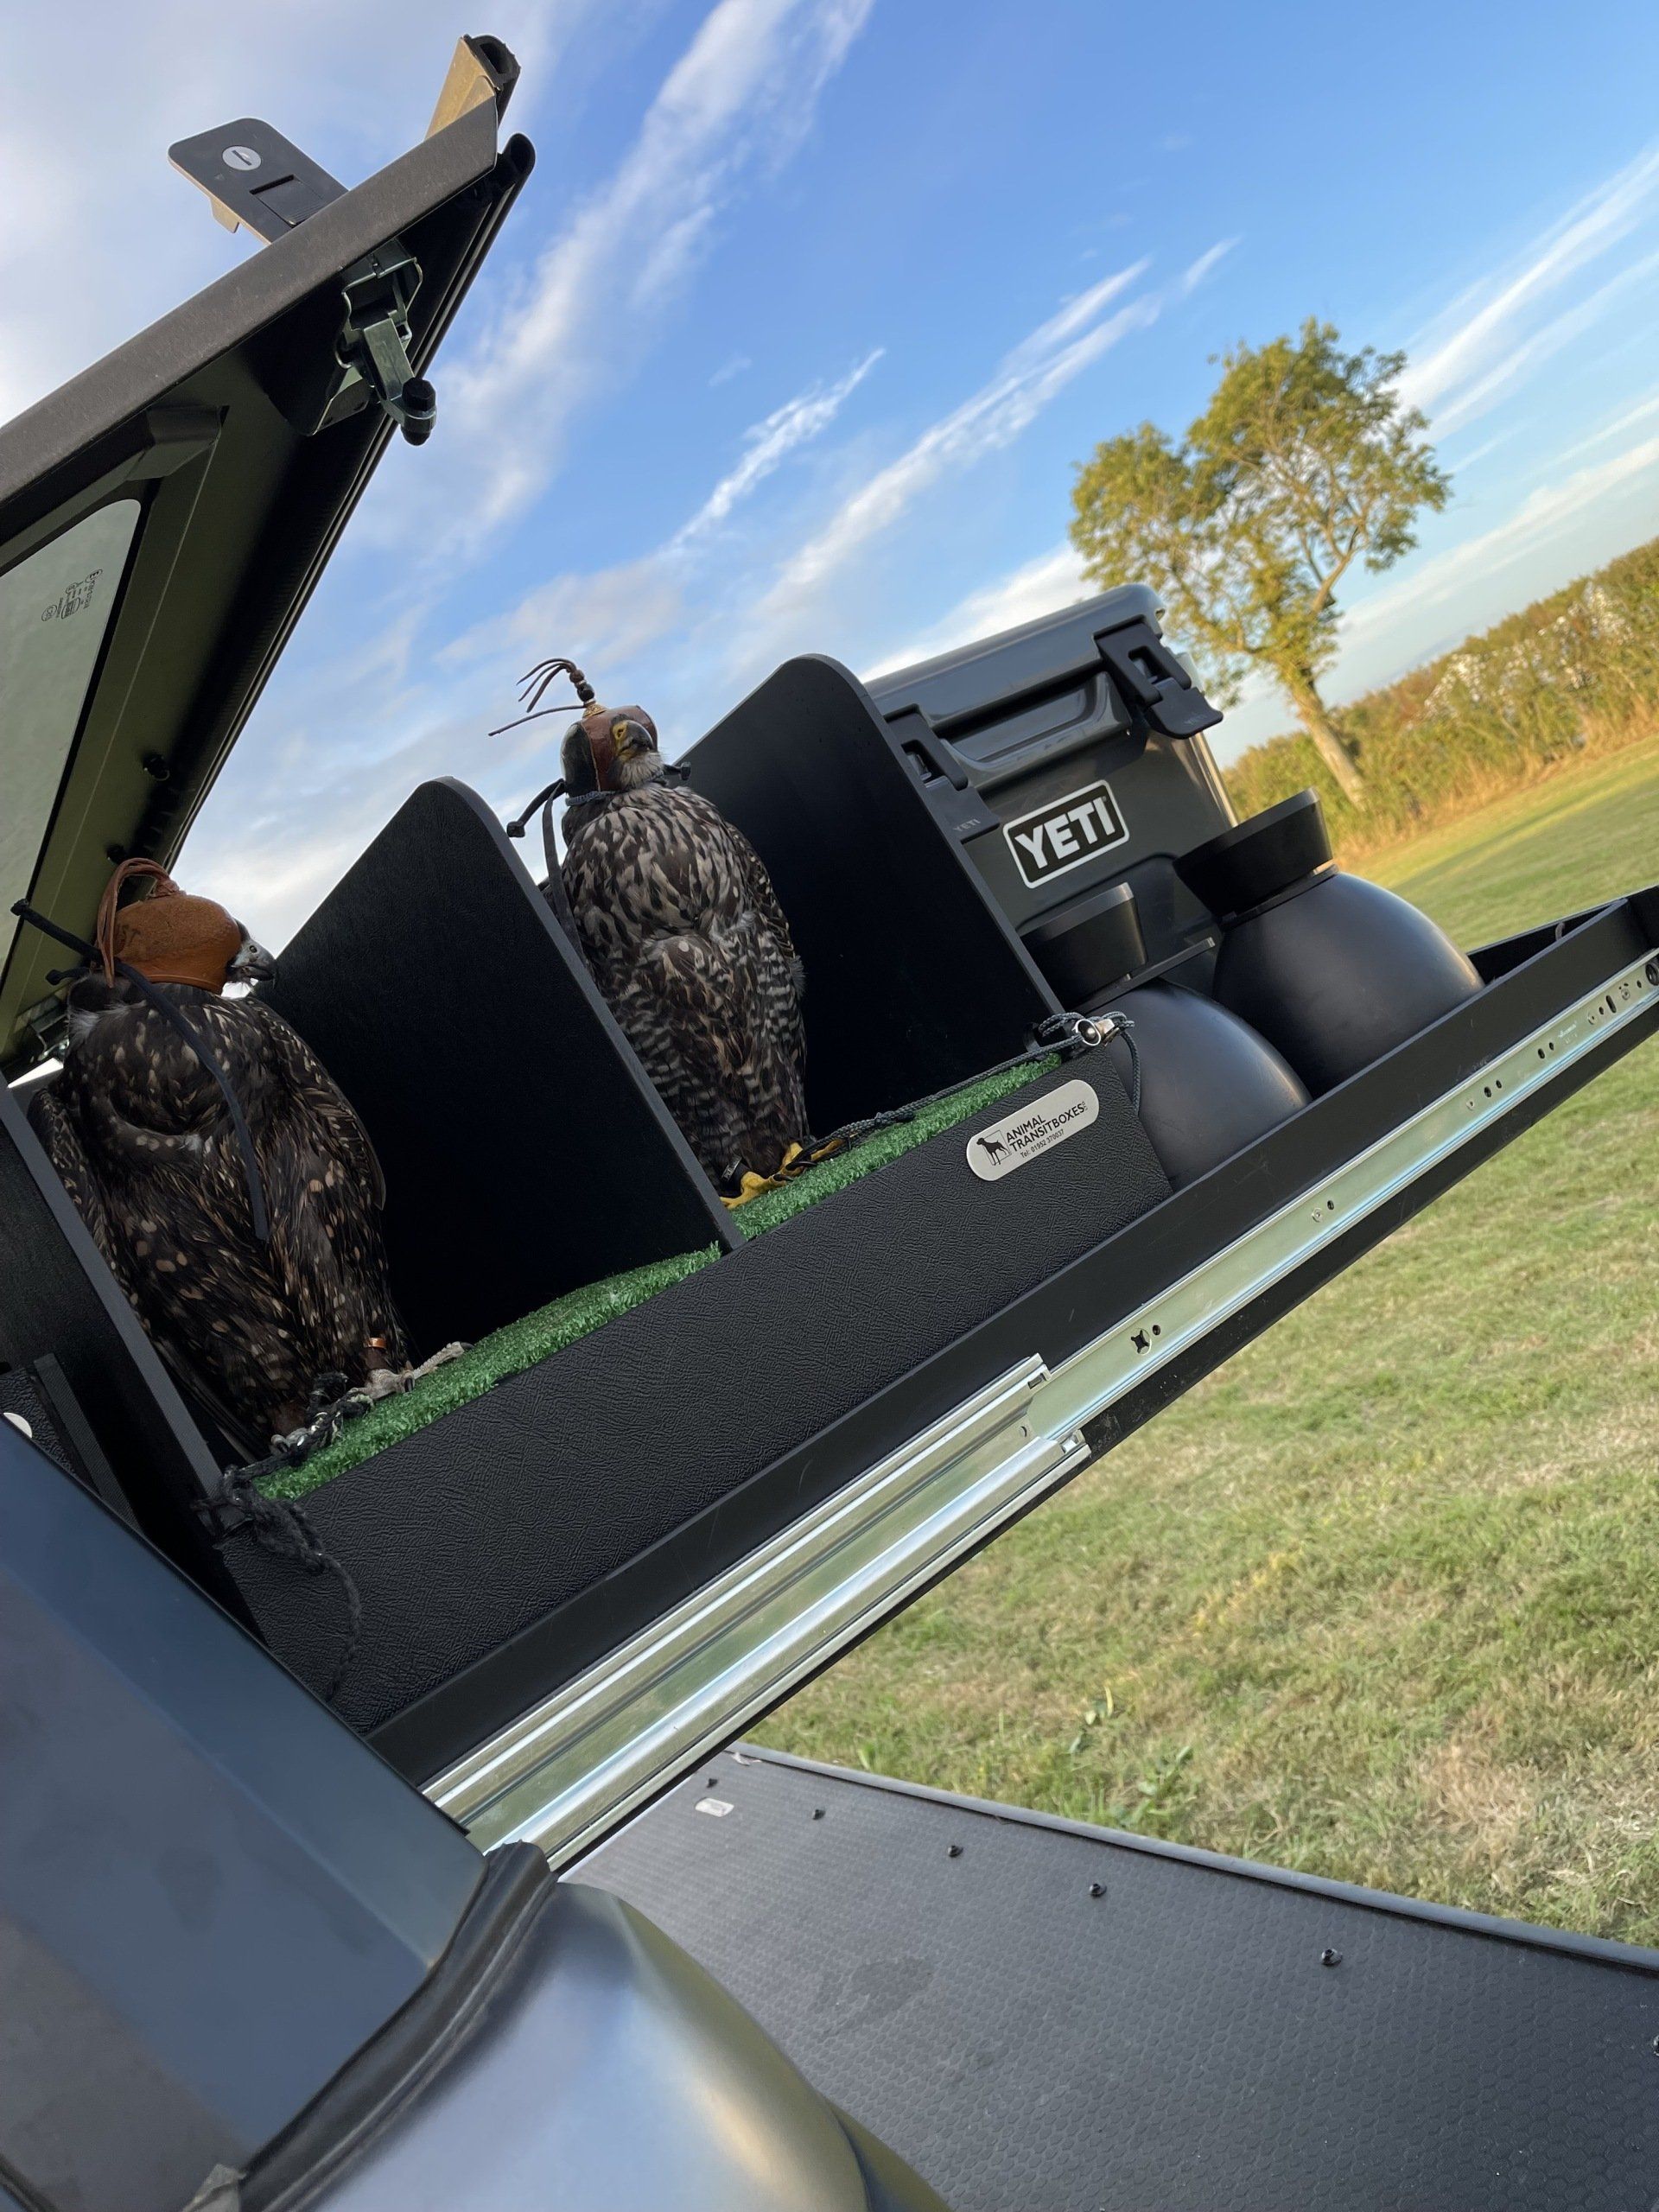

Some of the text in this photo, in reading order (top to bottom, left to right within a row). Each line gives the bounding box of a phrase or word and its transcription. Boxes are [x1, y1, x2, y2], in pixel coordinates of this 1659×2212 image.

[952, 818, 981, 833] YETI
[1014, 797, 1116, 869] YETI
[1006, 1115, 1046, 1143] ANIMAL
[1009, 1103, 1085, 1152] TRANSITBOXES
[1020, 1150, 1030, 1159] Tel:
[1031, 1140, 1046, 1153] 01952
